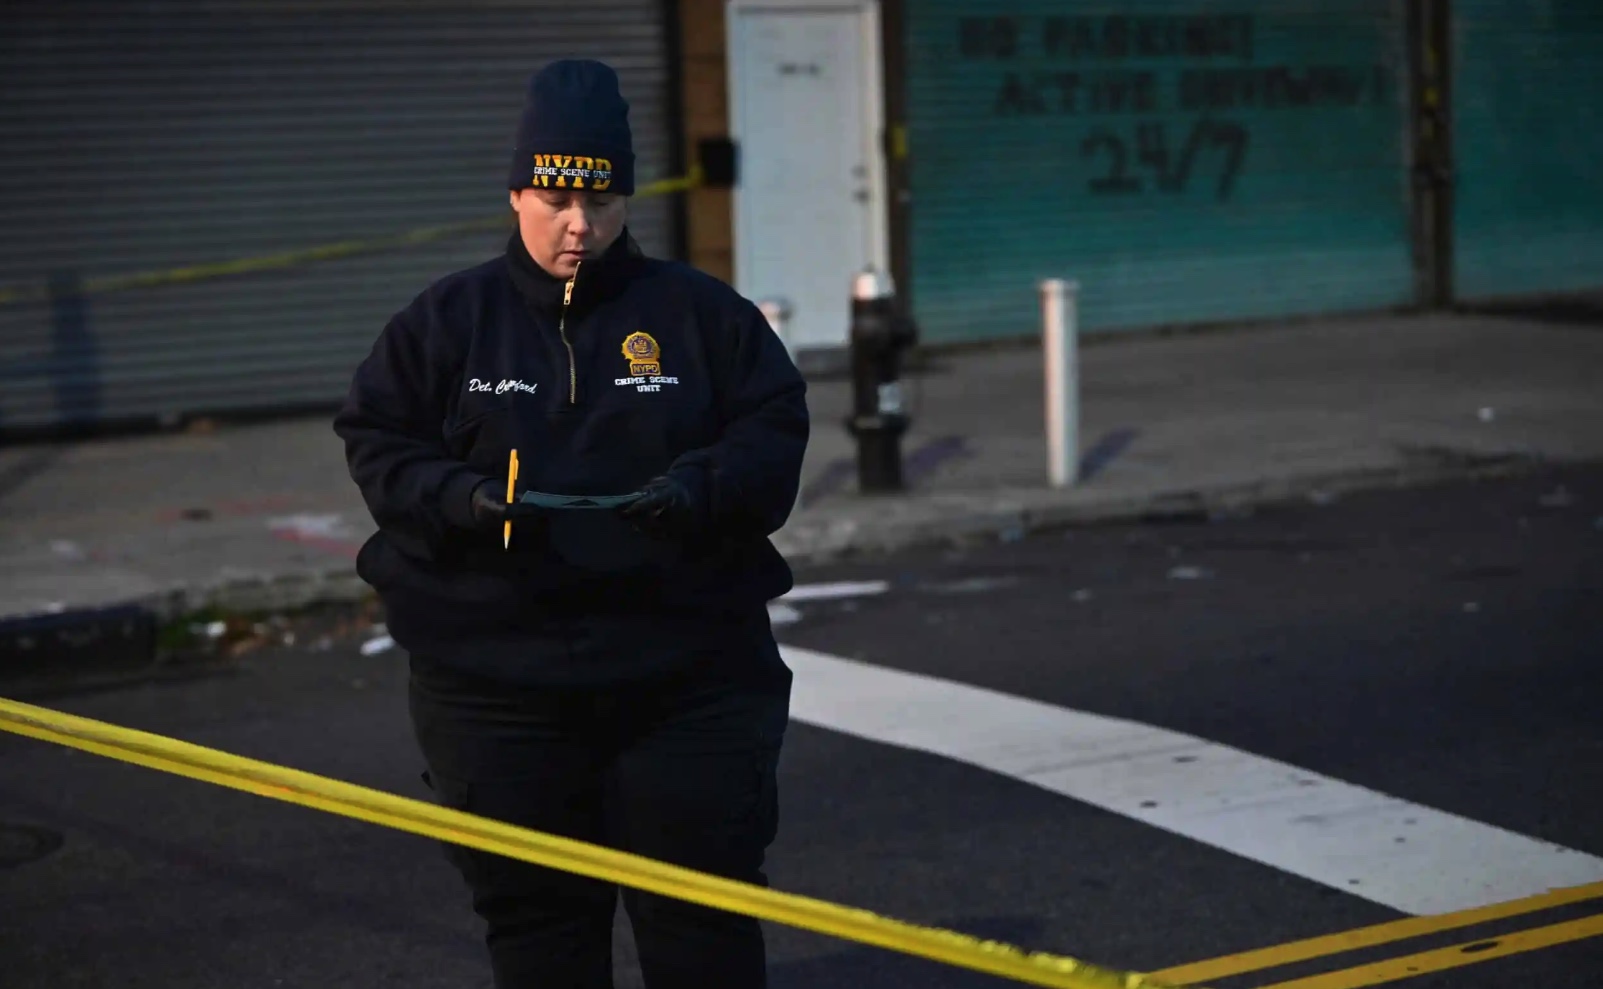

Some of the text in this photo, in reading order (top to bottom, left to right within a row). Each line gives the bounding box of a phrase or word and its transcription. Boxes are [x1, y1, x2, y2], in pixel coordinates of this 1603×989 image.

[1082, 120, 1250, 200] 24/7
[532, 154, 612, 191] NYPD
[533, 167, 558, 176] CRIME
[560, 168, 590, 178] SCENE
[633, 364, 658, 373] NYPD
[469, 378, 492, 392] Det.
[614, 376, 679, 386] CRIME SCENE
[636, 384, 661, 393] UNIT
